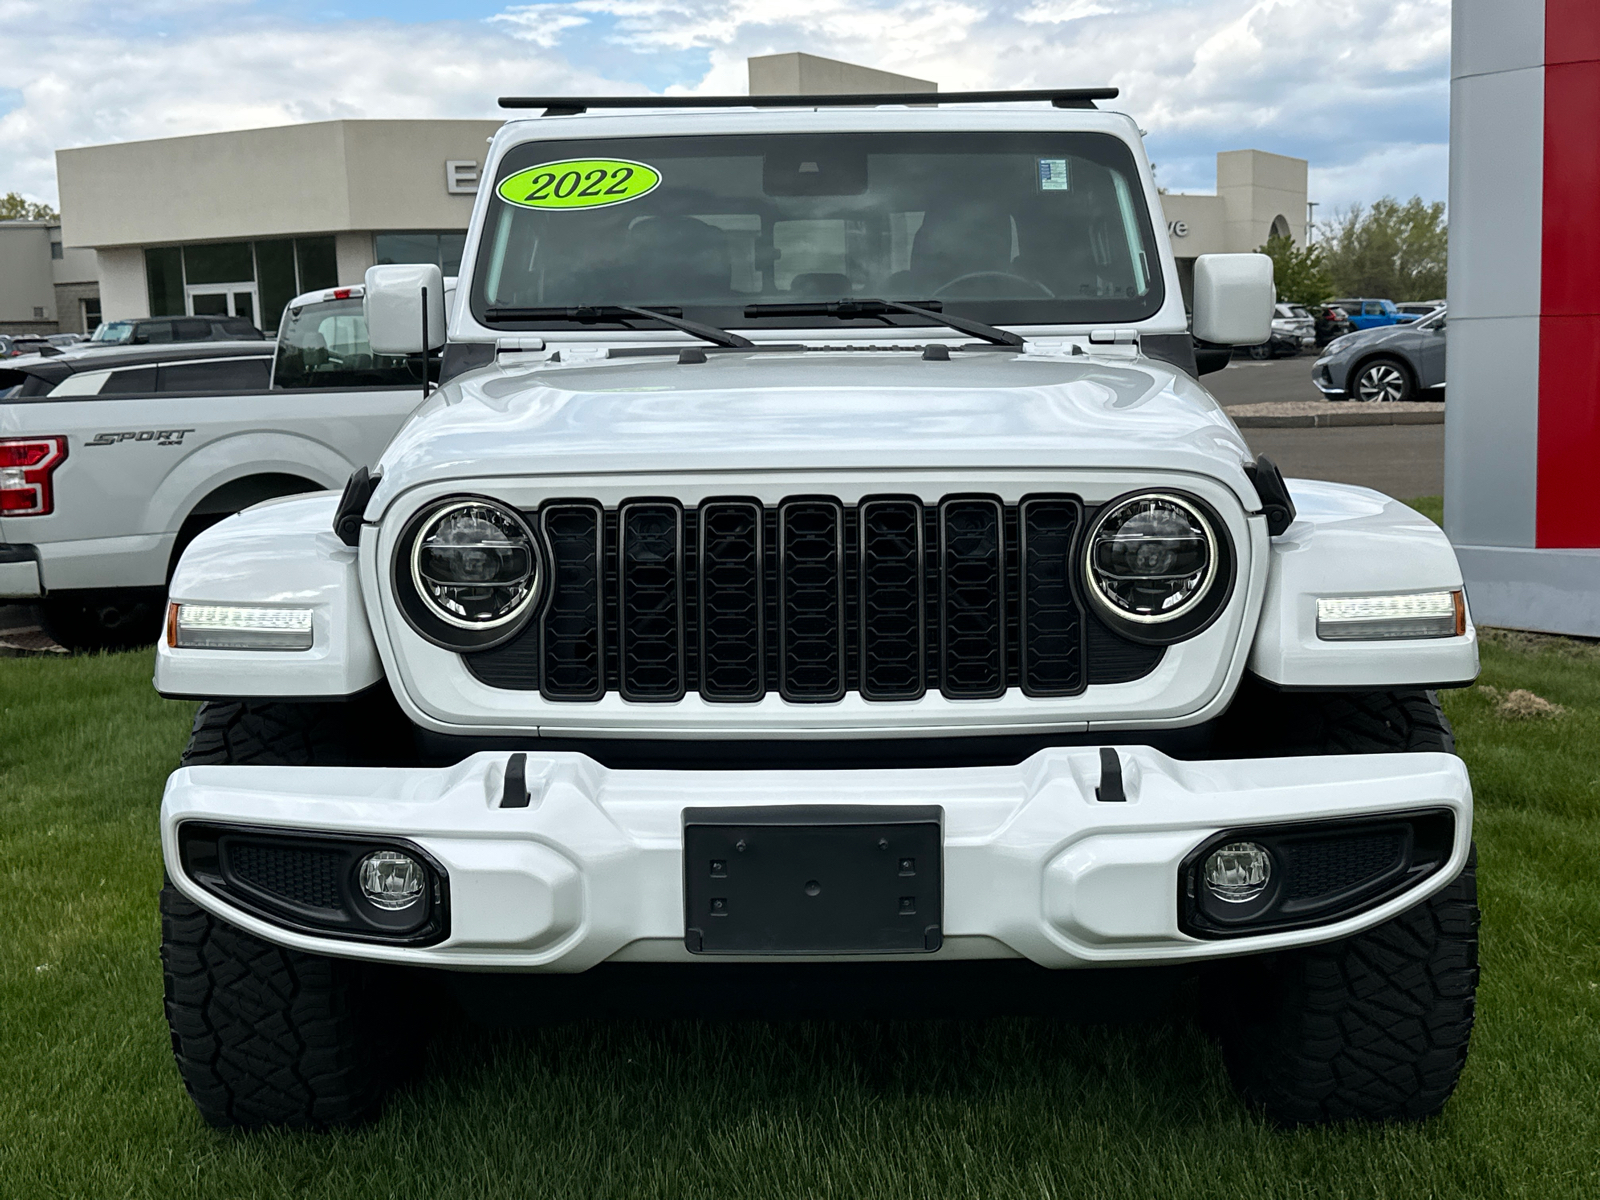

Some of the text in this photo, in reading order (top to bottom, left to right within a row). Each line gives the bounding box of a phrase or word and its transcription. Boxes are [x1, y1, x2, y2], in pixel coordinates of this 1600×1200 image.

[446, 160, 483, 194] E
[524, 167, 634, 201] 2022
[84, 429, 195, 446] SPORT
